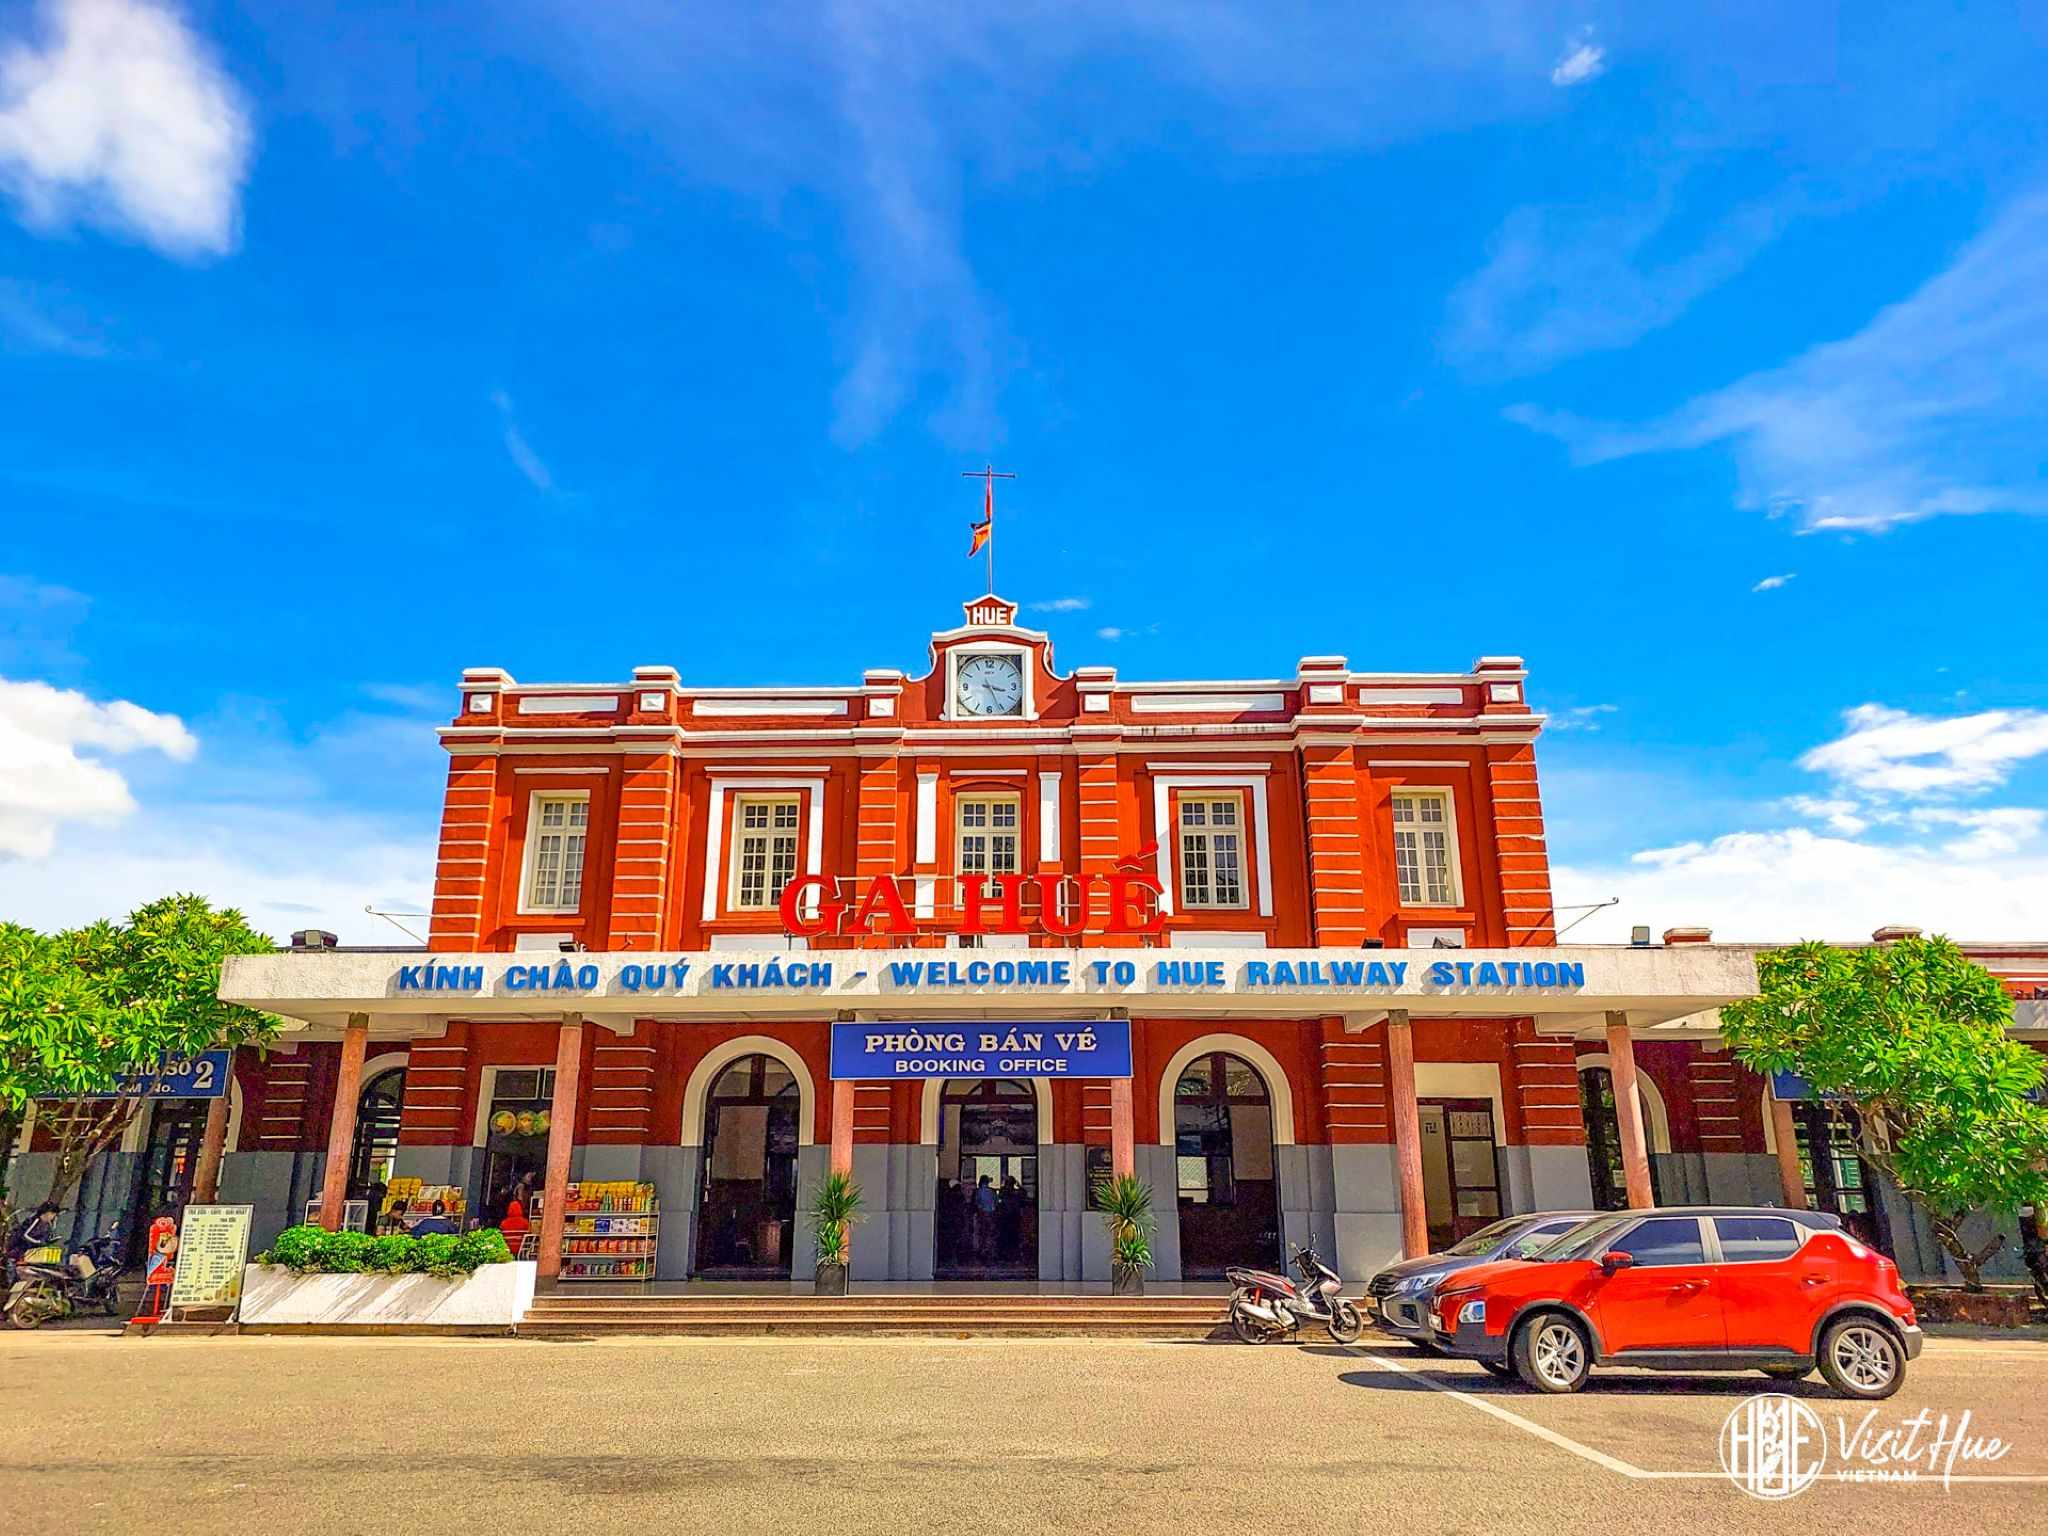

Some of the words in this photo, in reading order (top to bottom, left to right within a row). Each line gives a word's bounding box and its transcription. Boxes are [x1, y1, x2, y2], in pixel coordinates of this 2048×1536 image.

[972, 606, 1009, 625] HUE
[984, 660, 995, 669] 12
[962, 682, 969, 691] 9
[1010, 682, 1017, 691] 3
[986, 705, 993, 714] 6
[778, 873, 919, 936] GA
[956, 838, 1171, 936] HUẾ
[399, 957, 484, 991] KÍNH
[621, 957, 691, 993] QUÝ
[711, 956, 833, 989] KHÁCH
[890, 961, 1071, 986] WELCOME
[1091, 961, 1136, 986] TO
[1156, 961, 1226, 986] HUE
[1246, 961, 1409, 986] RAILWAY
[1431, 961, 1586, 988] STATION
[864, 1028, 966, 1053] PHÒNG
[978, 1027, 1044, 1052] BÁN
[1055, 1027, 1098, 1051] VÉ
[192, 1061, 214, 1089] 2
[894, 1059, 986, 1074] BOOKING
[999, 1059, 1068, 1072] OFFICE
